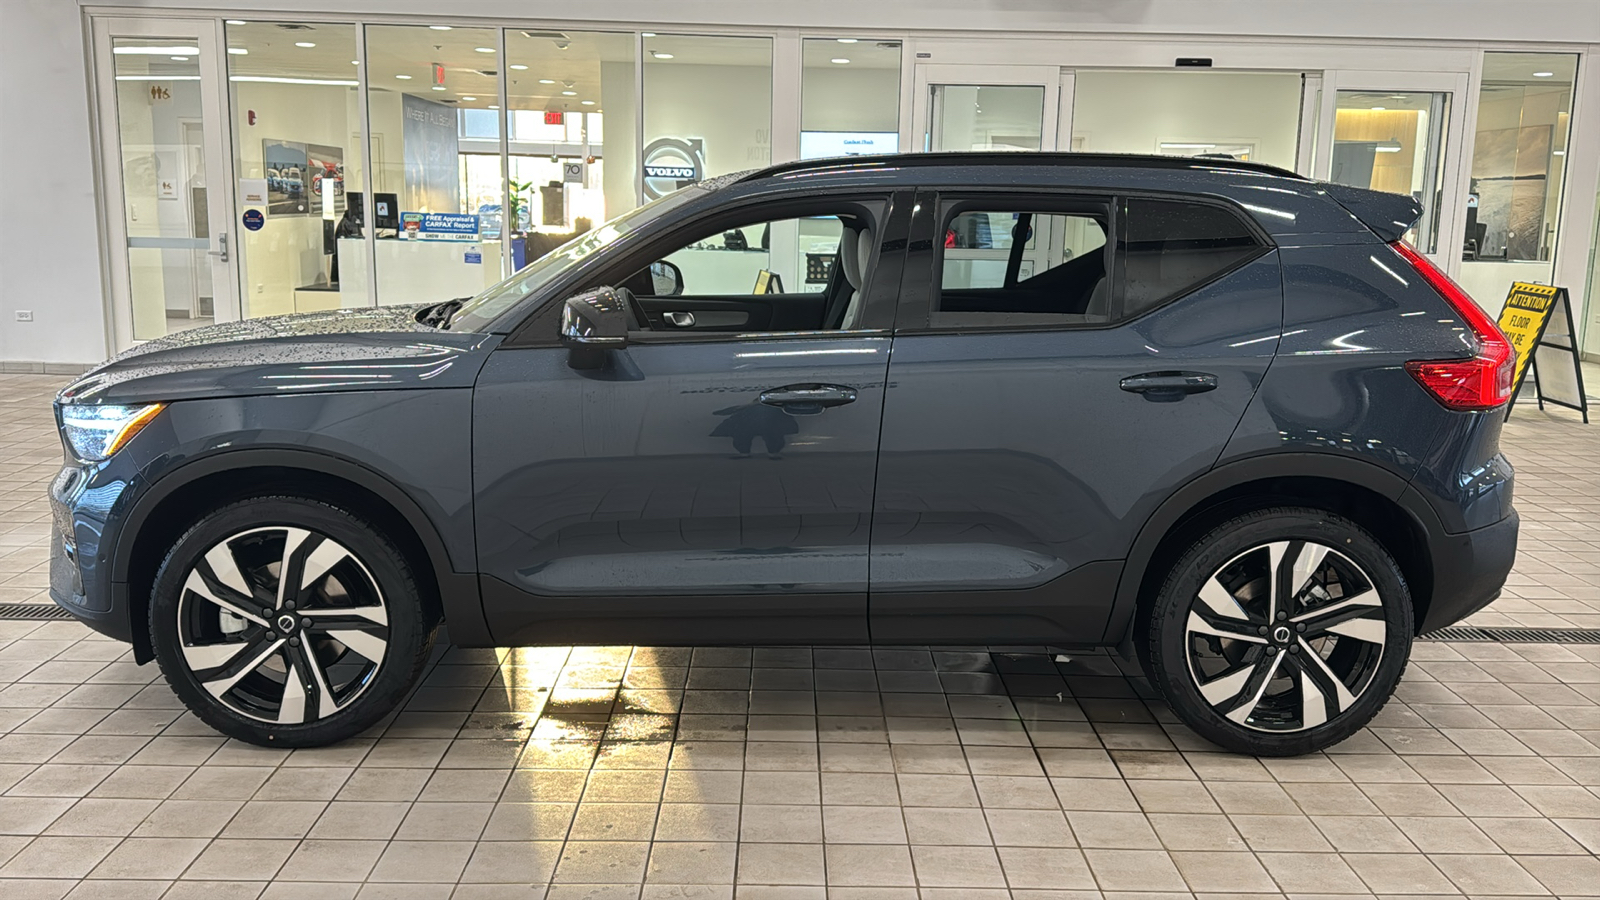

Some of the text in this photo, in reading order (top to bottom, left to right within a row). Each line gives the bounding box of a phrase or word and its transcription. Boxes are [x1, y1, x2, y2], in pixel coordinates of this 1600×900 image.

[546, 112, 562, 125] EXIT
[565, 165, 580, 175] 70
[645, 168, 693, 177] VOLVO
[443, 215, 469, 224] Appraisal
[1510, 293, 1548, 311] ATTENTION
[1509, 314, 1531, 329] FLOOR
[1514, 333, 1526, 346] BE
